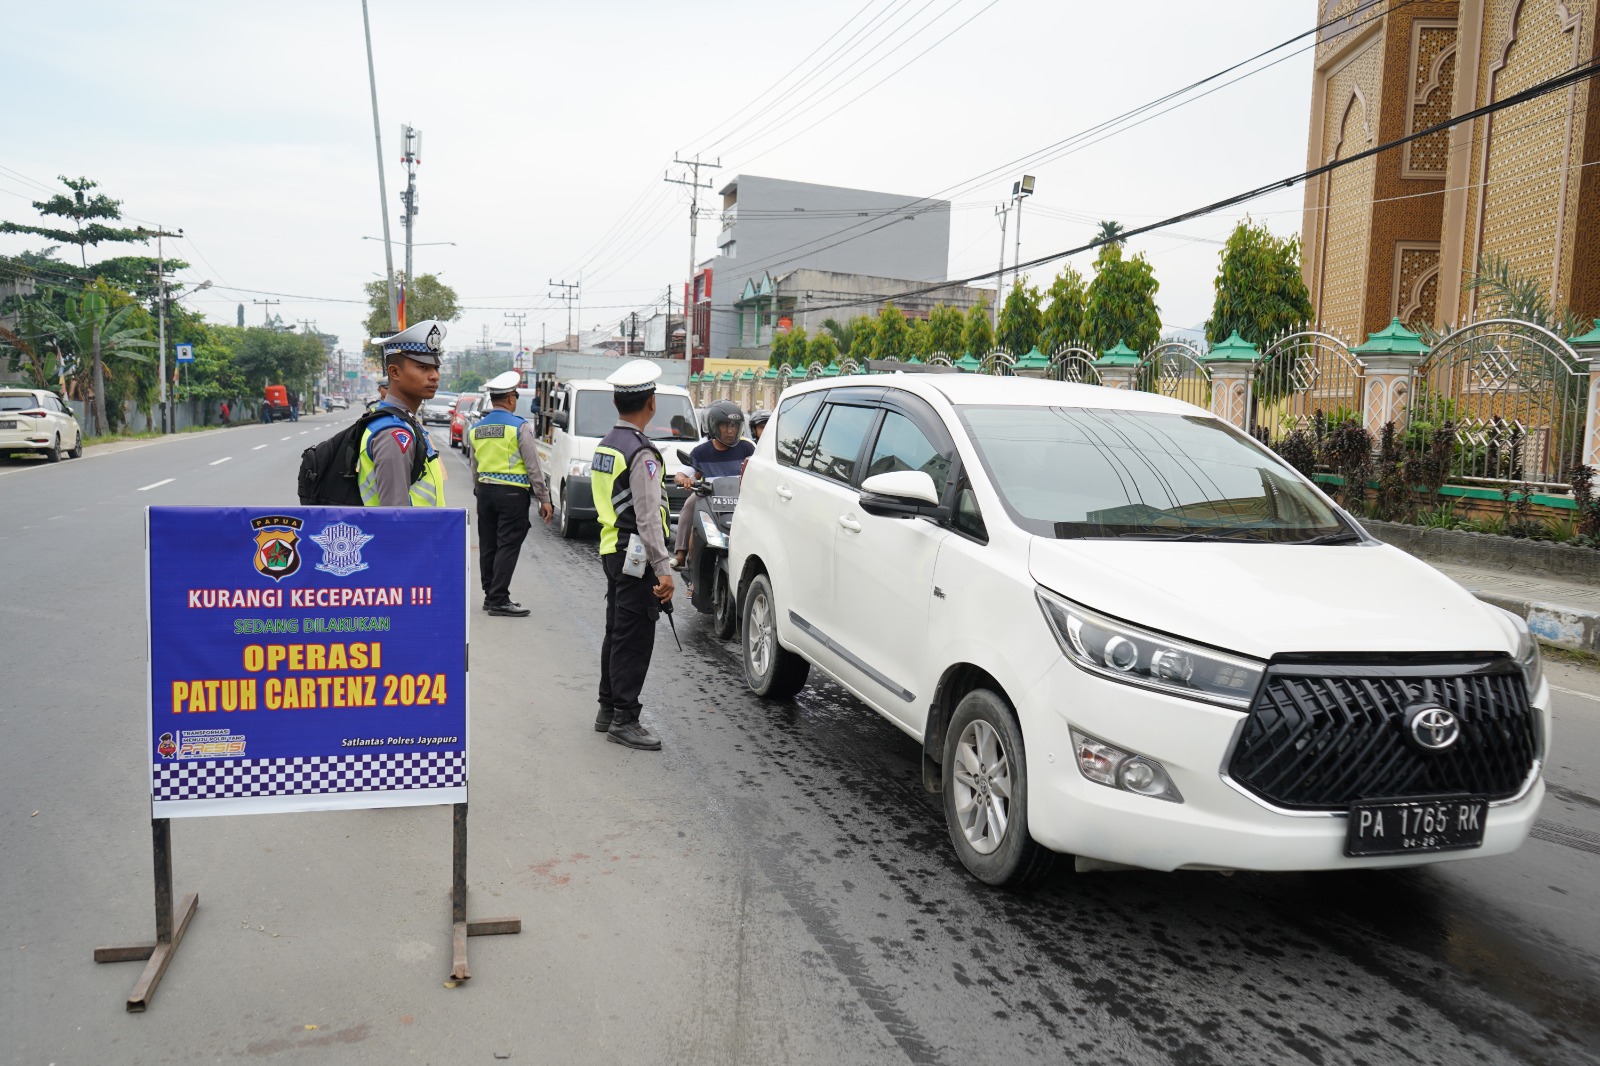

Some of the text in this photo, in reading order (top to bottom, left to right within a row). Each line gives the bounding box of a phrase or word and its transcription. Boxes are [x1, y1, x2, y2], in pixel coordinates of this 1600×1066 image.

[474, 427, 504, 438] POLISI
[713, 497, 721, 505] PA
[256, 518, 298, 527] PAPUA
[188, 587, 432, 608] KURANGI KECEPATAN !!!
[234, 616, 390, 634] SEDANG DILAKUKAN
[243, 641, 381, 672] OPERASI
[172, 673, 447, 713] PATUH CARTENZ 2024
[181, 741, 246, 755] PRESISI
[341, 735, 458, 747] Satlantas Polres Jayapura
[1359, 804, 1481, 838] PA 1765 RK
